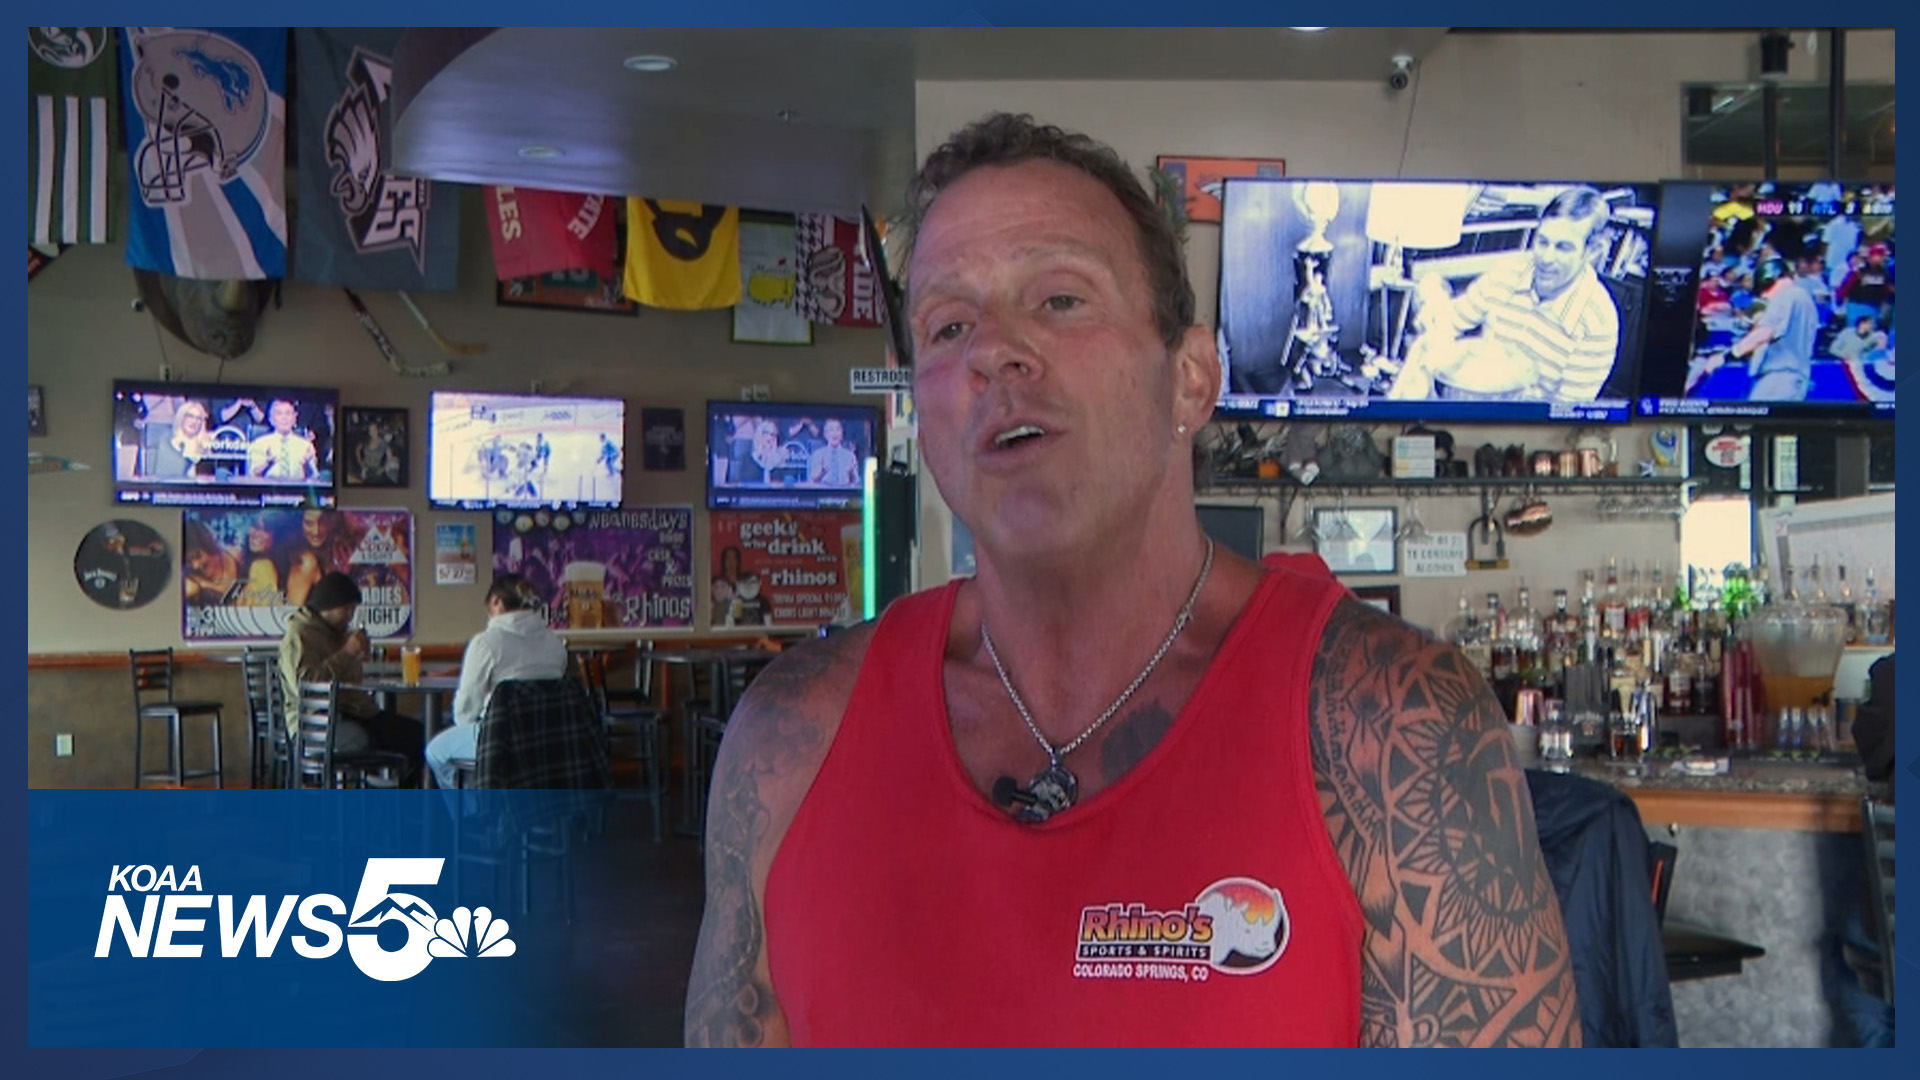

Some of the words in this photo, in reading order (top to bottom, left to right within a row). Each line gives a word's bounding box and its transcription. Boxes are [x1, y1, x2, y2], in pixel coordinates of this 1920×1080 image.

[853, 370, 909, 383] RESTROO
[768, 538, 825, 555] drink
[361, 551, 394, 560] LIGHT
[770, 568, 837, 586] rhinos
[361, 586, 401, 606] ADIES
[367, 607, 400, 624] IGHT
[622, 592, 692, 627] Rhinos
[1080, 905, 1214, 943] Rhino's
[1082, 945, 1132, 956] SPORTS
[1139, 946, 1148, 956] &
[1154, 946, 1208, 958] SPIRITS
[1073, 963, 1132, 979] COLORADO
[1136, 964, 1189, 982] SPRINGS,
[1192, 966, 1209, 982] CO
